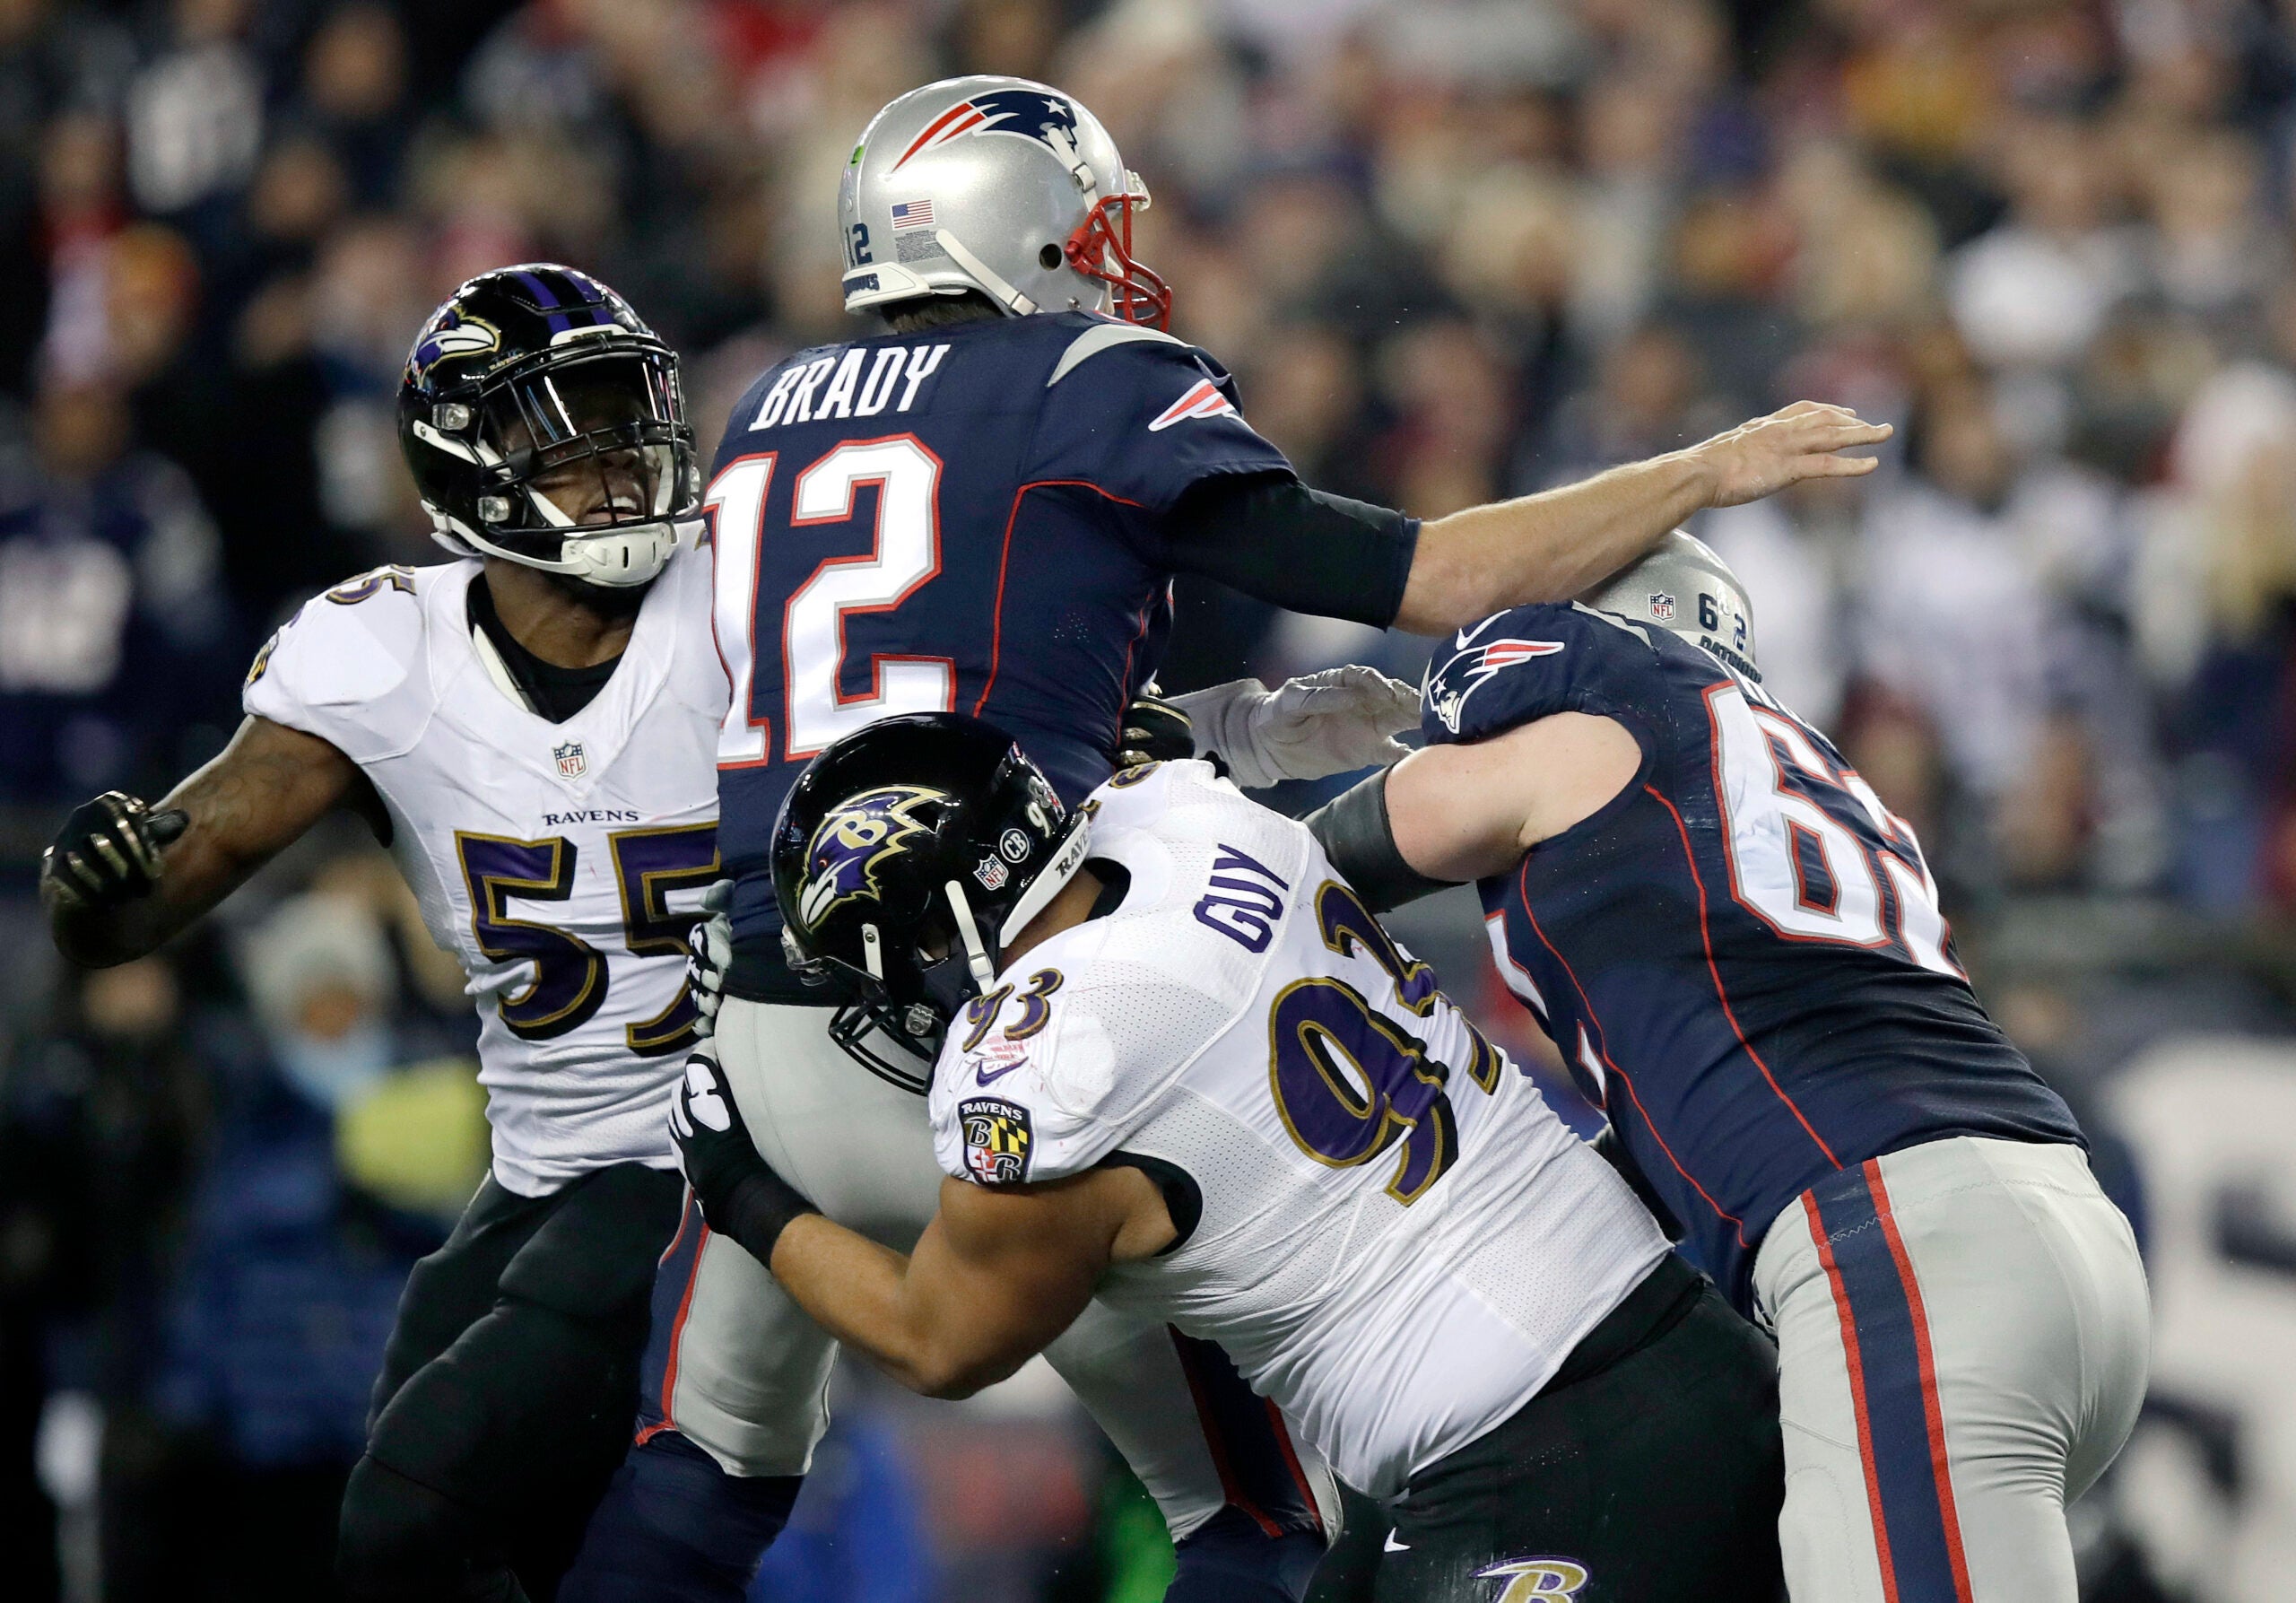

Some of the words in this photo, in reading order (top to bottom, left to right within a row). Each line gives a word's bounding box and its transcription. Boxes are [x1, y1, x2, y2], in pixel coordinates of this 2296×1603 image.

[748, 344, 951, 431] BRADY
[701, 431, 956, 770] 12
[1653, 604, 1673, 617] NFL
[559, 756, 584, 775] NFL
[542, 810, 639, 826] RAVENS
[1004, 832, 1028, 859] CB
[985, 867, 1005, 886] NFL
[1193, 843, 1289, 954] GUY
[454, 821, 720, 1059] 55
[962, 968, 1065, 1053] 93
[1268, 878, 1504, 1207] 93
[961, 1102, 1023, 1120] RAVENS
